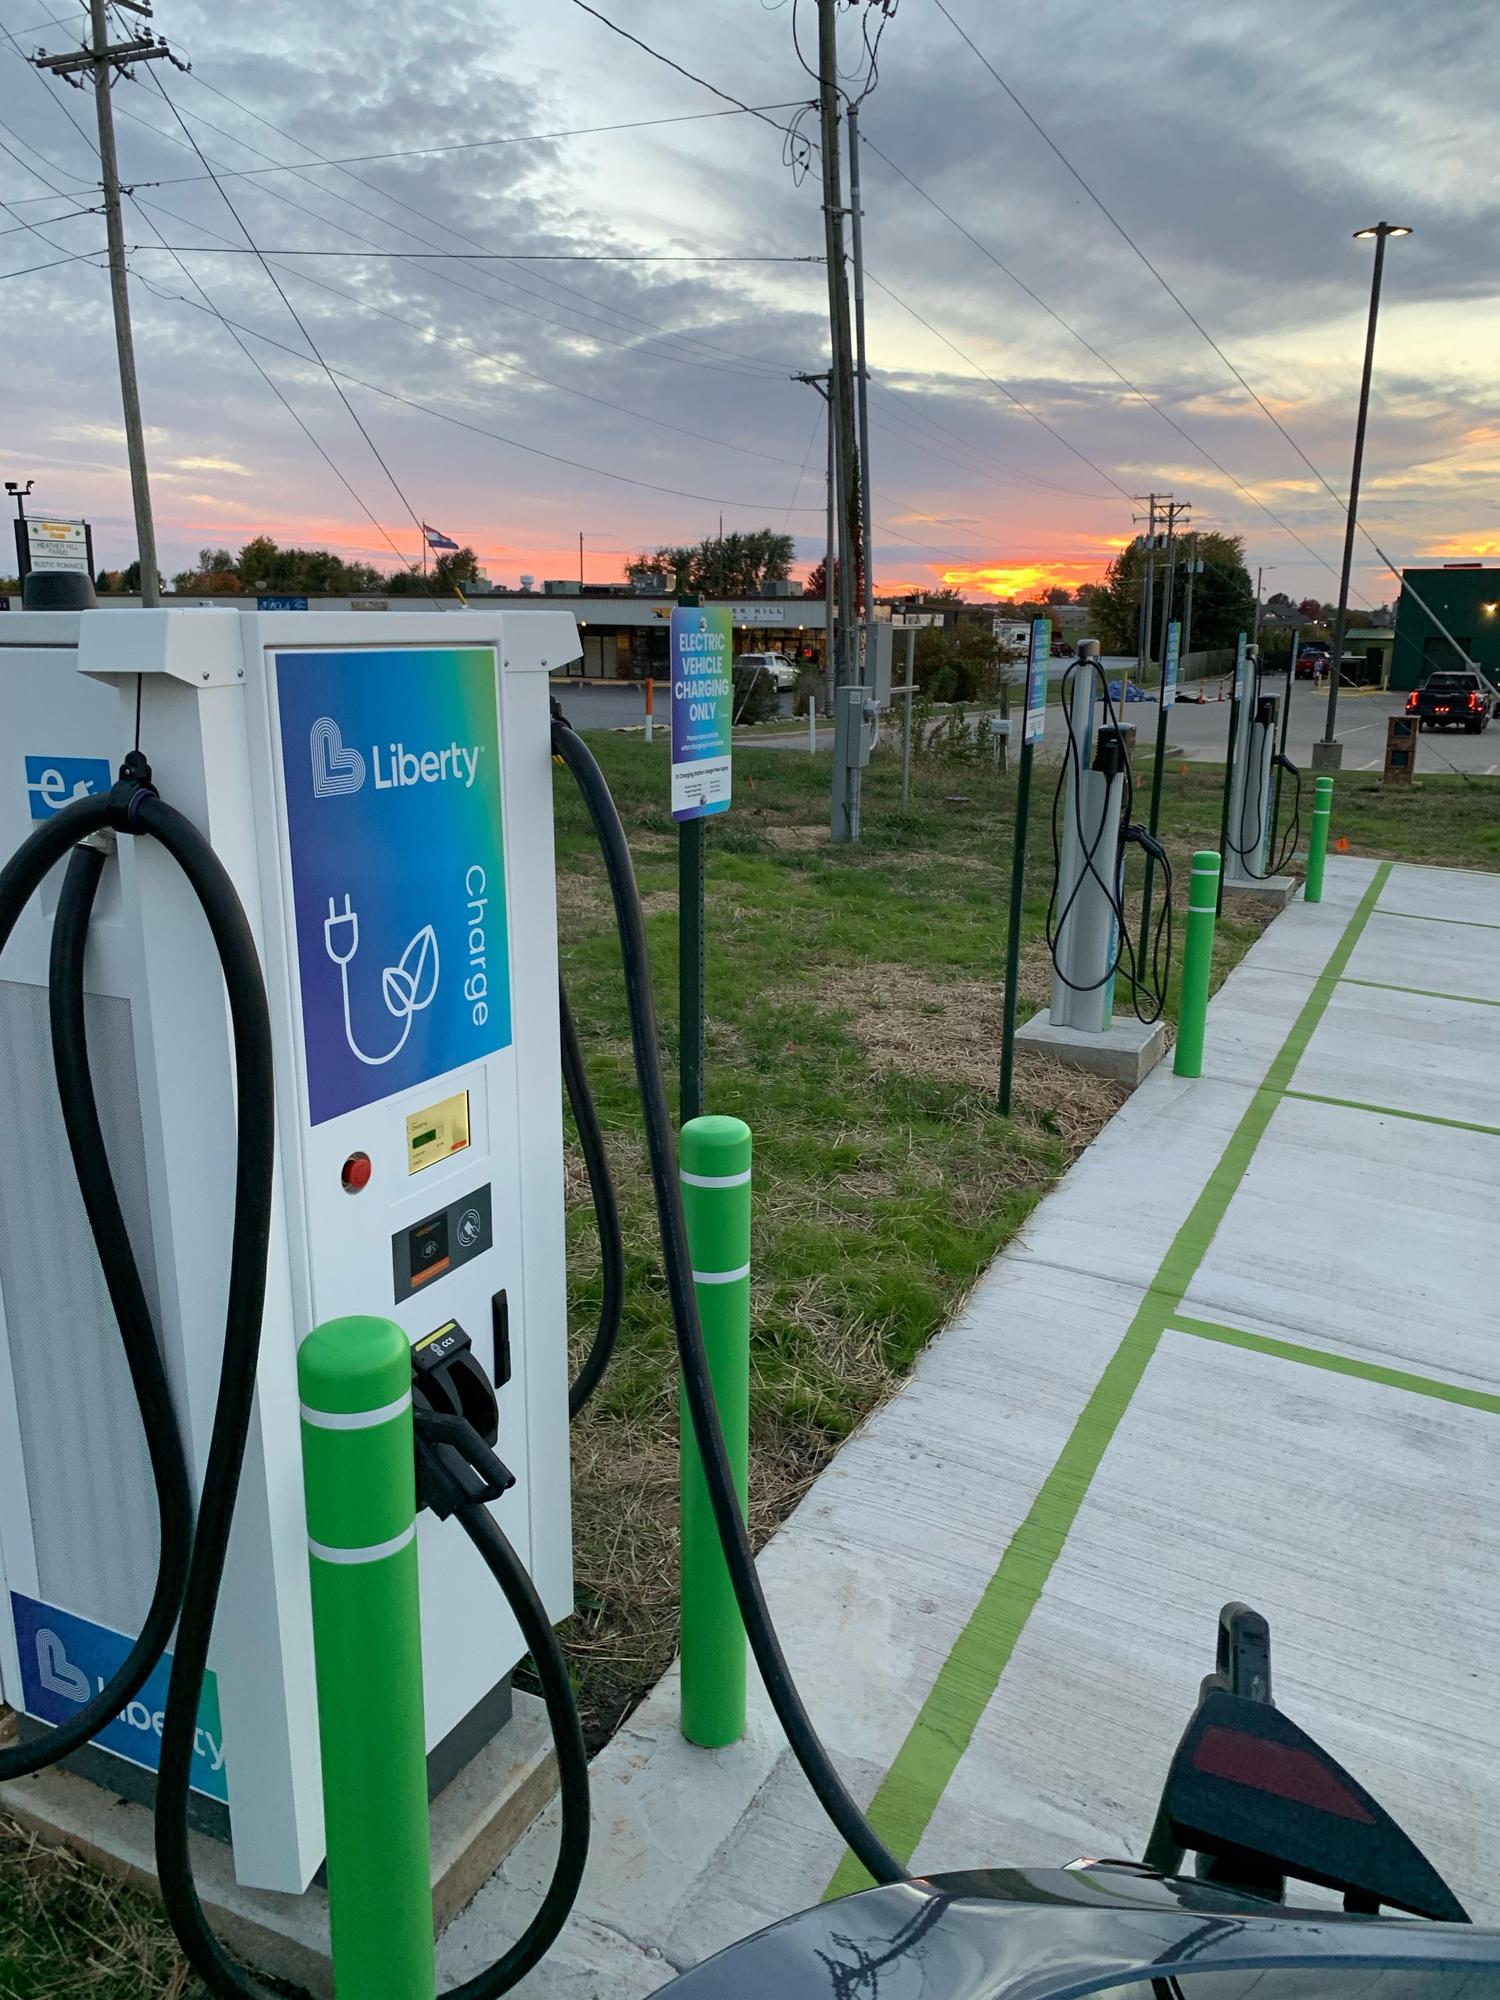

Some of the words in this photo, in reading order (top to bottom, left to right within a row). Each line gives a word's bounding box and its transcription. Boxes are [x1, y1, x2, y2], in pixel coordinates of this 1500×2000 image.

[679, 632, 726, 652] ELECTRIC
[682, 656, 723, 676] VEHICLE
[675, 679, 729, 700] CHARGING
[689, 702, 716, 722] ONLY
[372, 741, 479, 790] Liberty
[464, 864, 489, 1027] Charge
[441, 1336, 455, 1348] CCS
